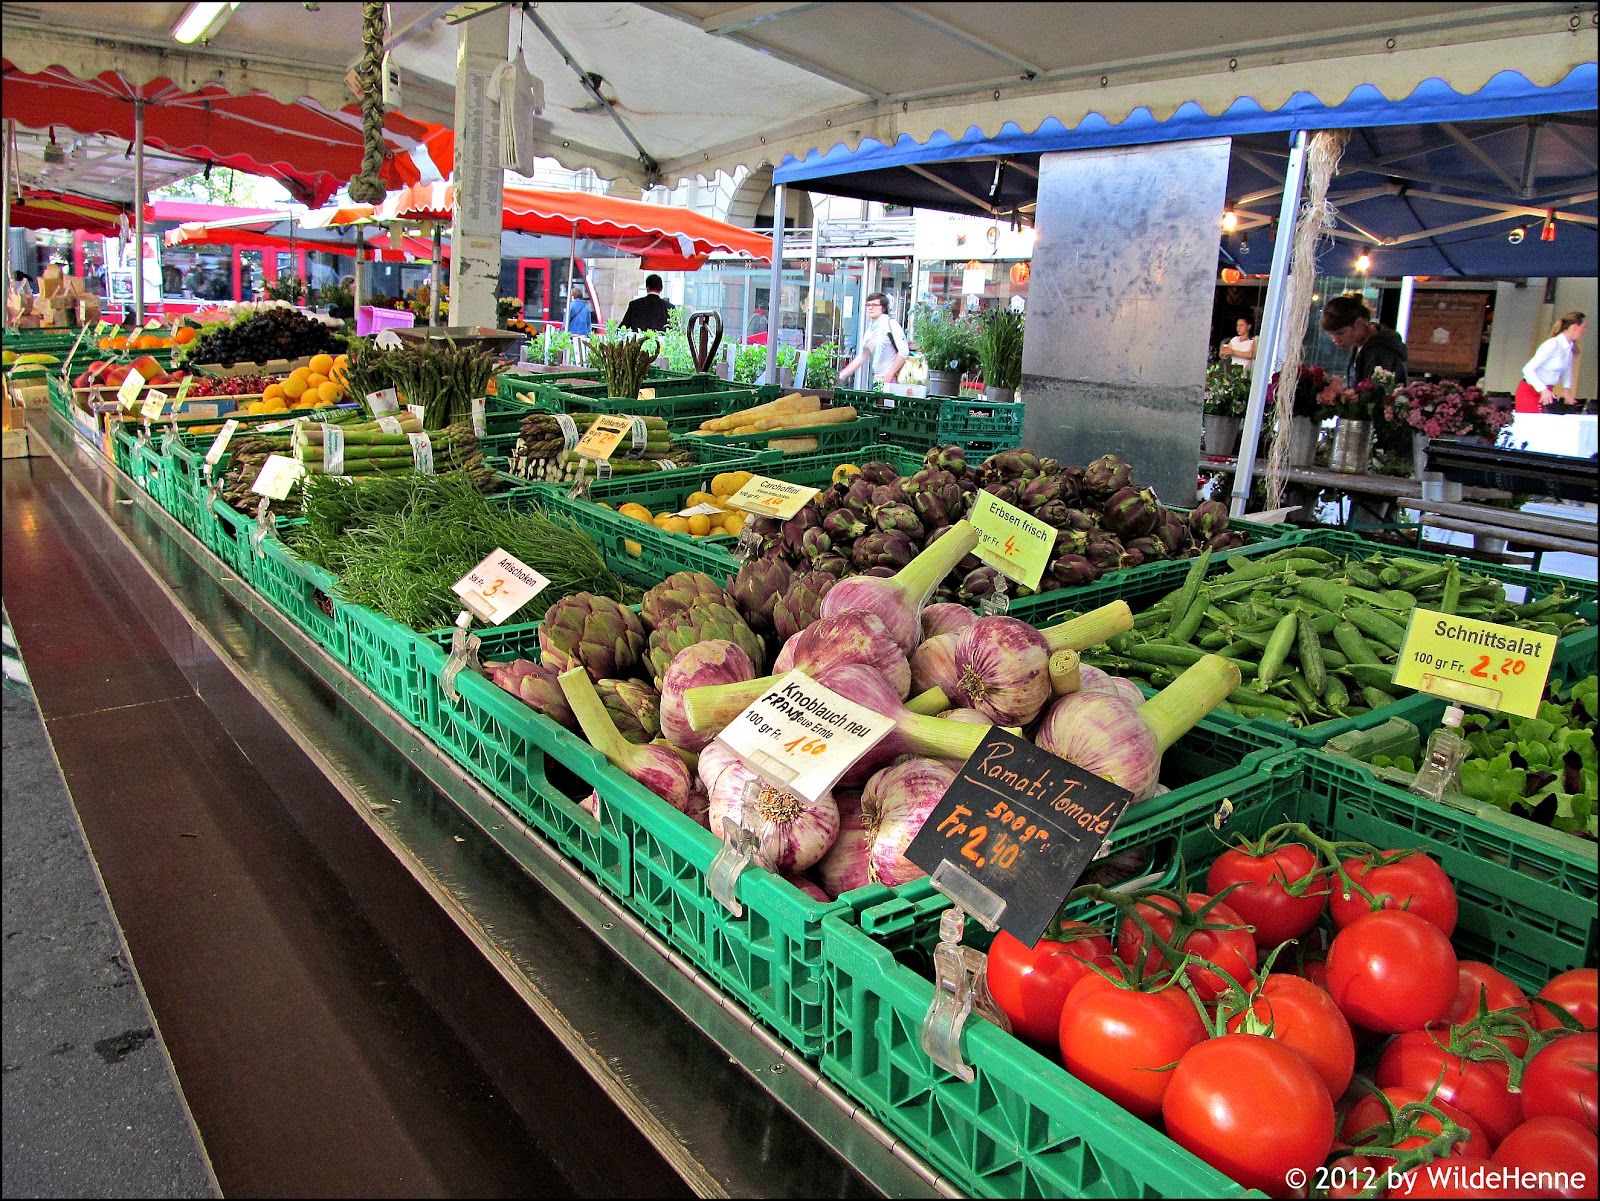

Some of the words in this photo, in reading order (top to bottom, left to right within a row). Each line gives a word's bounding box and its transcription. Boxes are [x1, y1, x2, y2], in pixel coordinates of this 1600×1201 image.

[973, 525, 983, 537] 00
[982, 532, 991, 543] gr
[992, 538, 1000, 548] Fr.
[989, 502, 1021, 527] Erbsen
[1021, 520, 1047, 542] frisch
[497, 558, 537, 587] Artischoken
[1434, 620, 1542, 658] Schnittsalat
[1414, 651, 1433, 665] 100
[1434, 657, 1449, 670] gr
[1450, 659, 1466, 673] Fr.
[1470, 655, 1526, 682] 2.20
[781, 682, 848, 727] Knoblauch
[844, 719, 871, 738] neu
[745, 710, 762, 726] 100
[758, 721, 773, 734] gr
[771, 728, 782, 741] Fr.
[783, 735, 827, 756] 1.60
[810, 723, 834, 739] Ernte
[977, 741, 1054, 800] Ramati
[1050, 778, 1115, 835] Tomate
